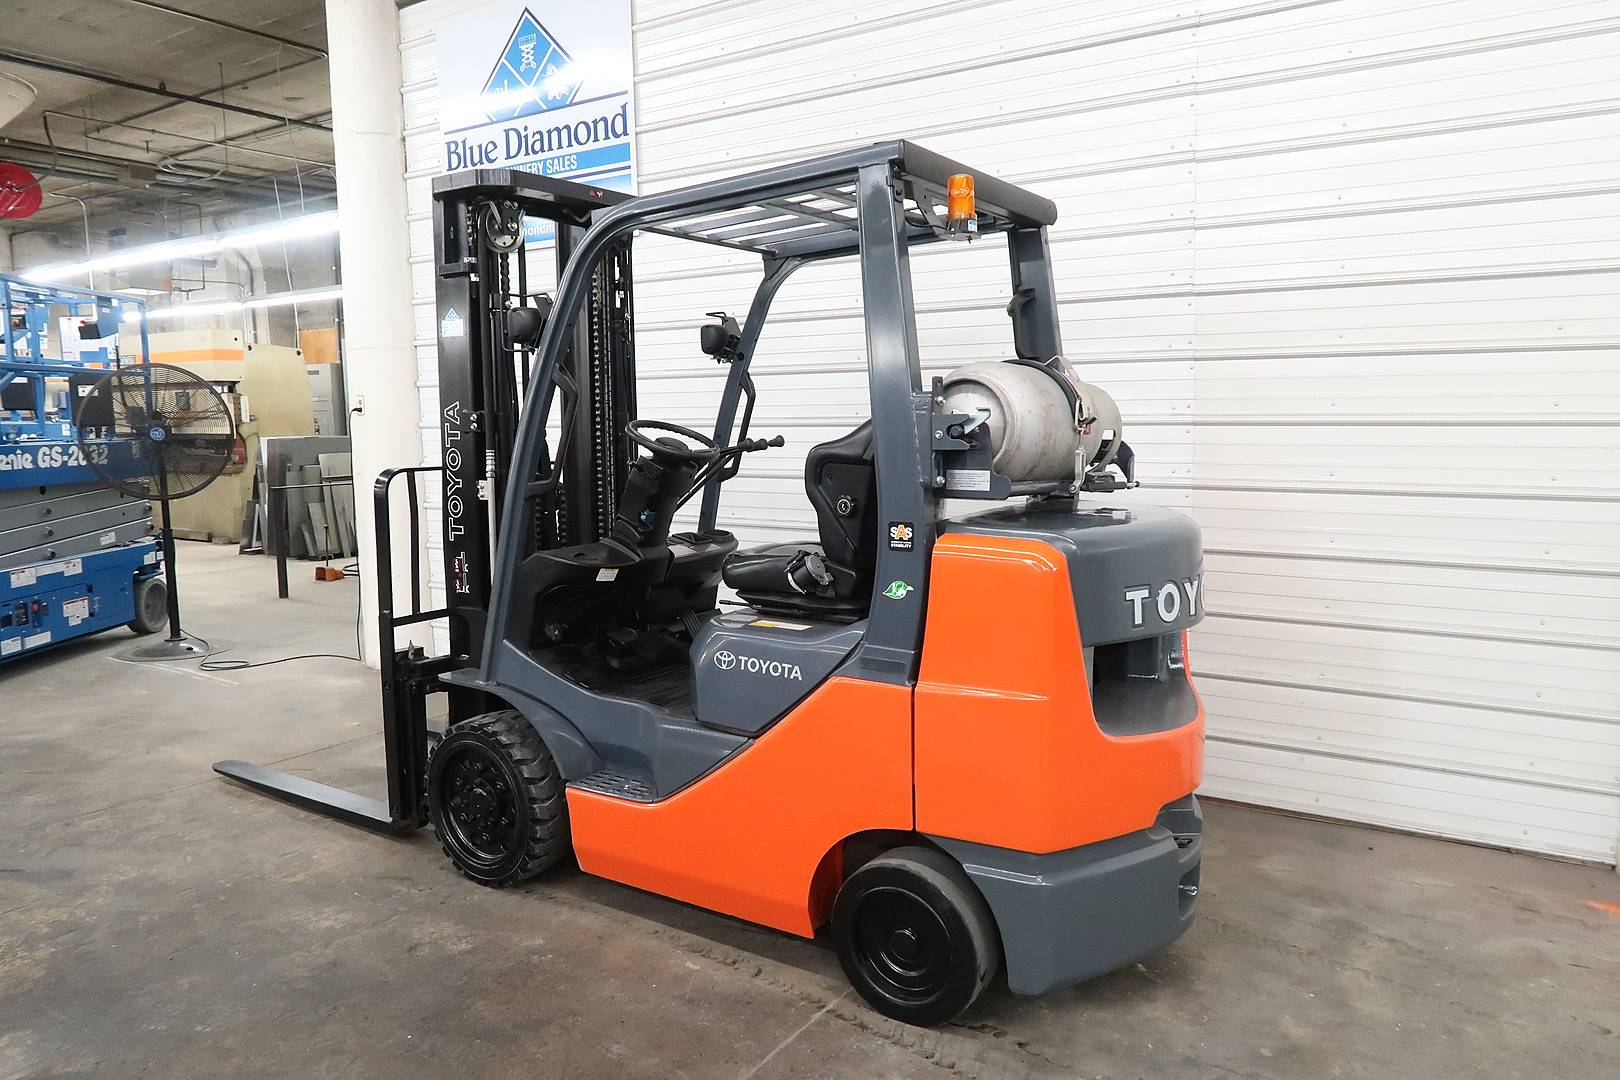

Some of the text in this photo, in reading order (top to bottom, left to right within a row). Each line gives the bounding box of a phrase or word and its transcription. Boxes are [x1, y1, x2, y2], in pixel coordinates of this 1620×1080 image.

[444, 102, 630, 172] Blue Diamond
[546, 154, 578, 174] SALES
[444, 400, 465, 541] TOYOTA
[890, 524, 913, 540] SAS
[738, 655, 802, 681] TOYOTA
